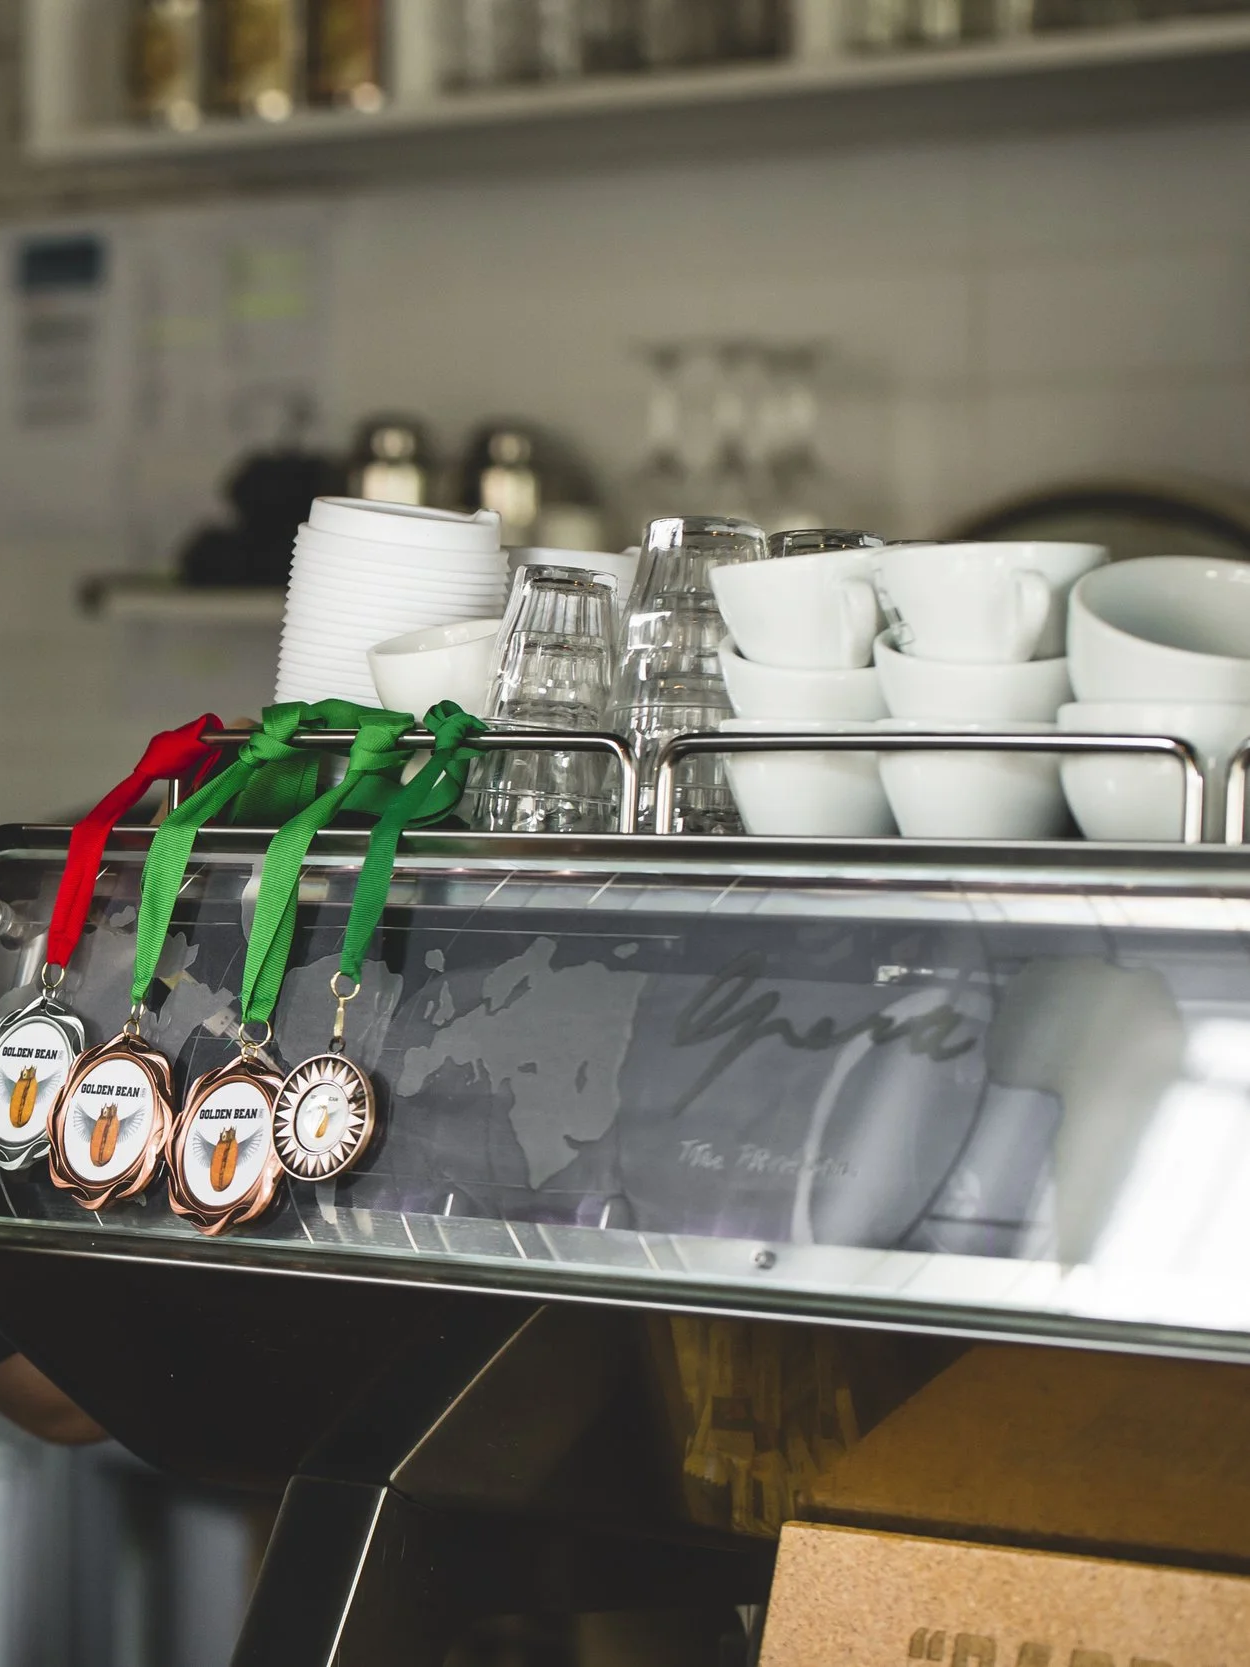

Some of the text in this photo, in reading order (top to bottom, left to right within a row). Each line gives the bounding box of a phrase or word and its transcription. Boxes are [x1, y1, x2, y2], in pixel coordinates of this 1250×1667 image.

[2, 1046, 34, 1058] GOLDEN
[35, 1048, 58, 1060] BEAN
[81, 1084, 115, 1096] GOLDEN
[116, 1086, 140, 1098] BEAN
[199, 1108, 233, 1120] GOLDEN
[234, 1108, 258, 1120] BEAN
